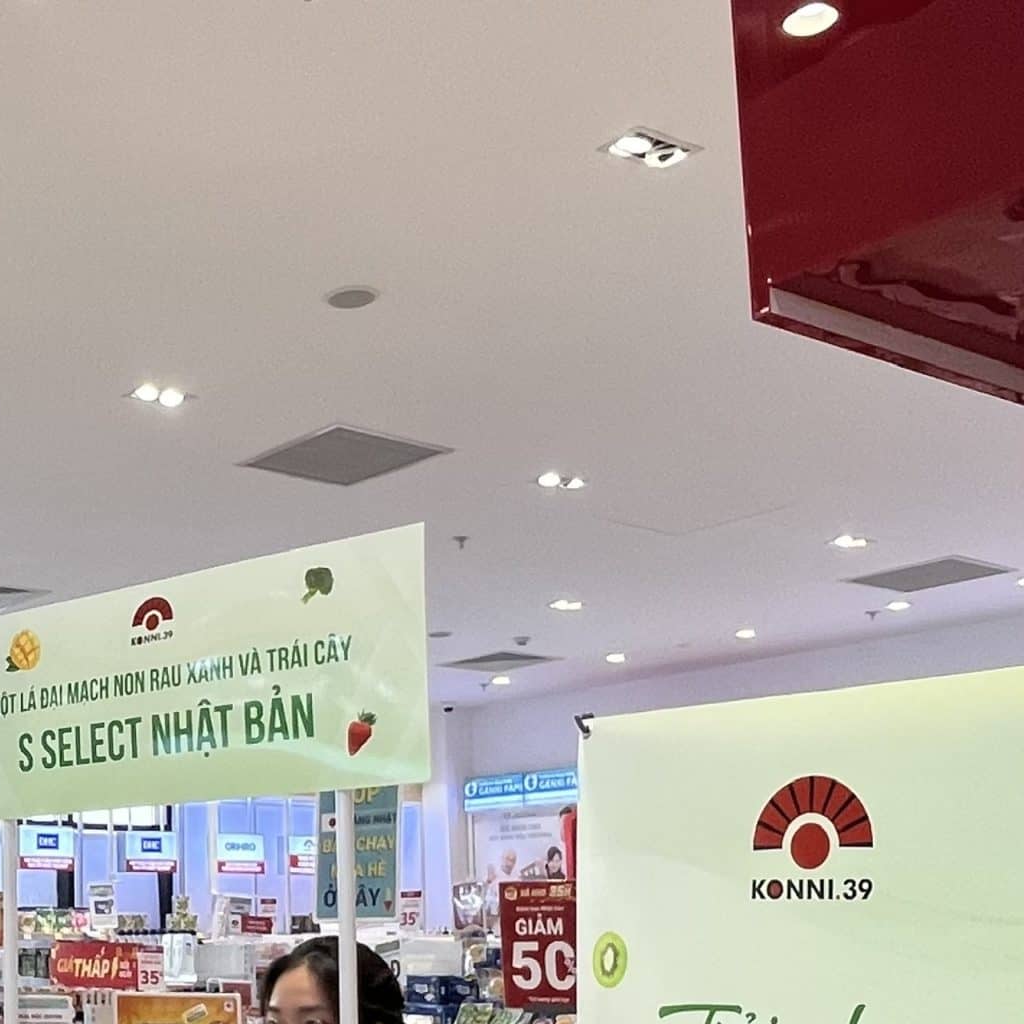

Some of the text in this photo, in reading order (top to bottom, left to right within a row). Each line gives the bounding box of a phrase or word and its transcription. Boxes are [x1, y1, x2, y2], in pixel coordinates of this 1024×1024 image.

[130, 630, 174, 647] KONNI.39
[20, 682, 37, 713] LÁ
[40, 683, 63, 711] ĐẠI
[67, 678, 109, 708] MẠCH
[114, 673, 145, 698] NON
[150, 663, 182, 690] RAU
[187, 654, 234, 685] XANH
[239, 646, 262, 677] VÀ
[267, 640, 309, 674] TRÁI
[314, 633, 352, 666] CÂY
[18, 684, 315, 773] S SELECT NHẬT BẢN
[356, 886, 382, 908] ÂY
[751, 877, 874, 901] KONNI.39
[514, 912, 564, 936] GIẢM
